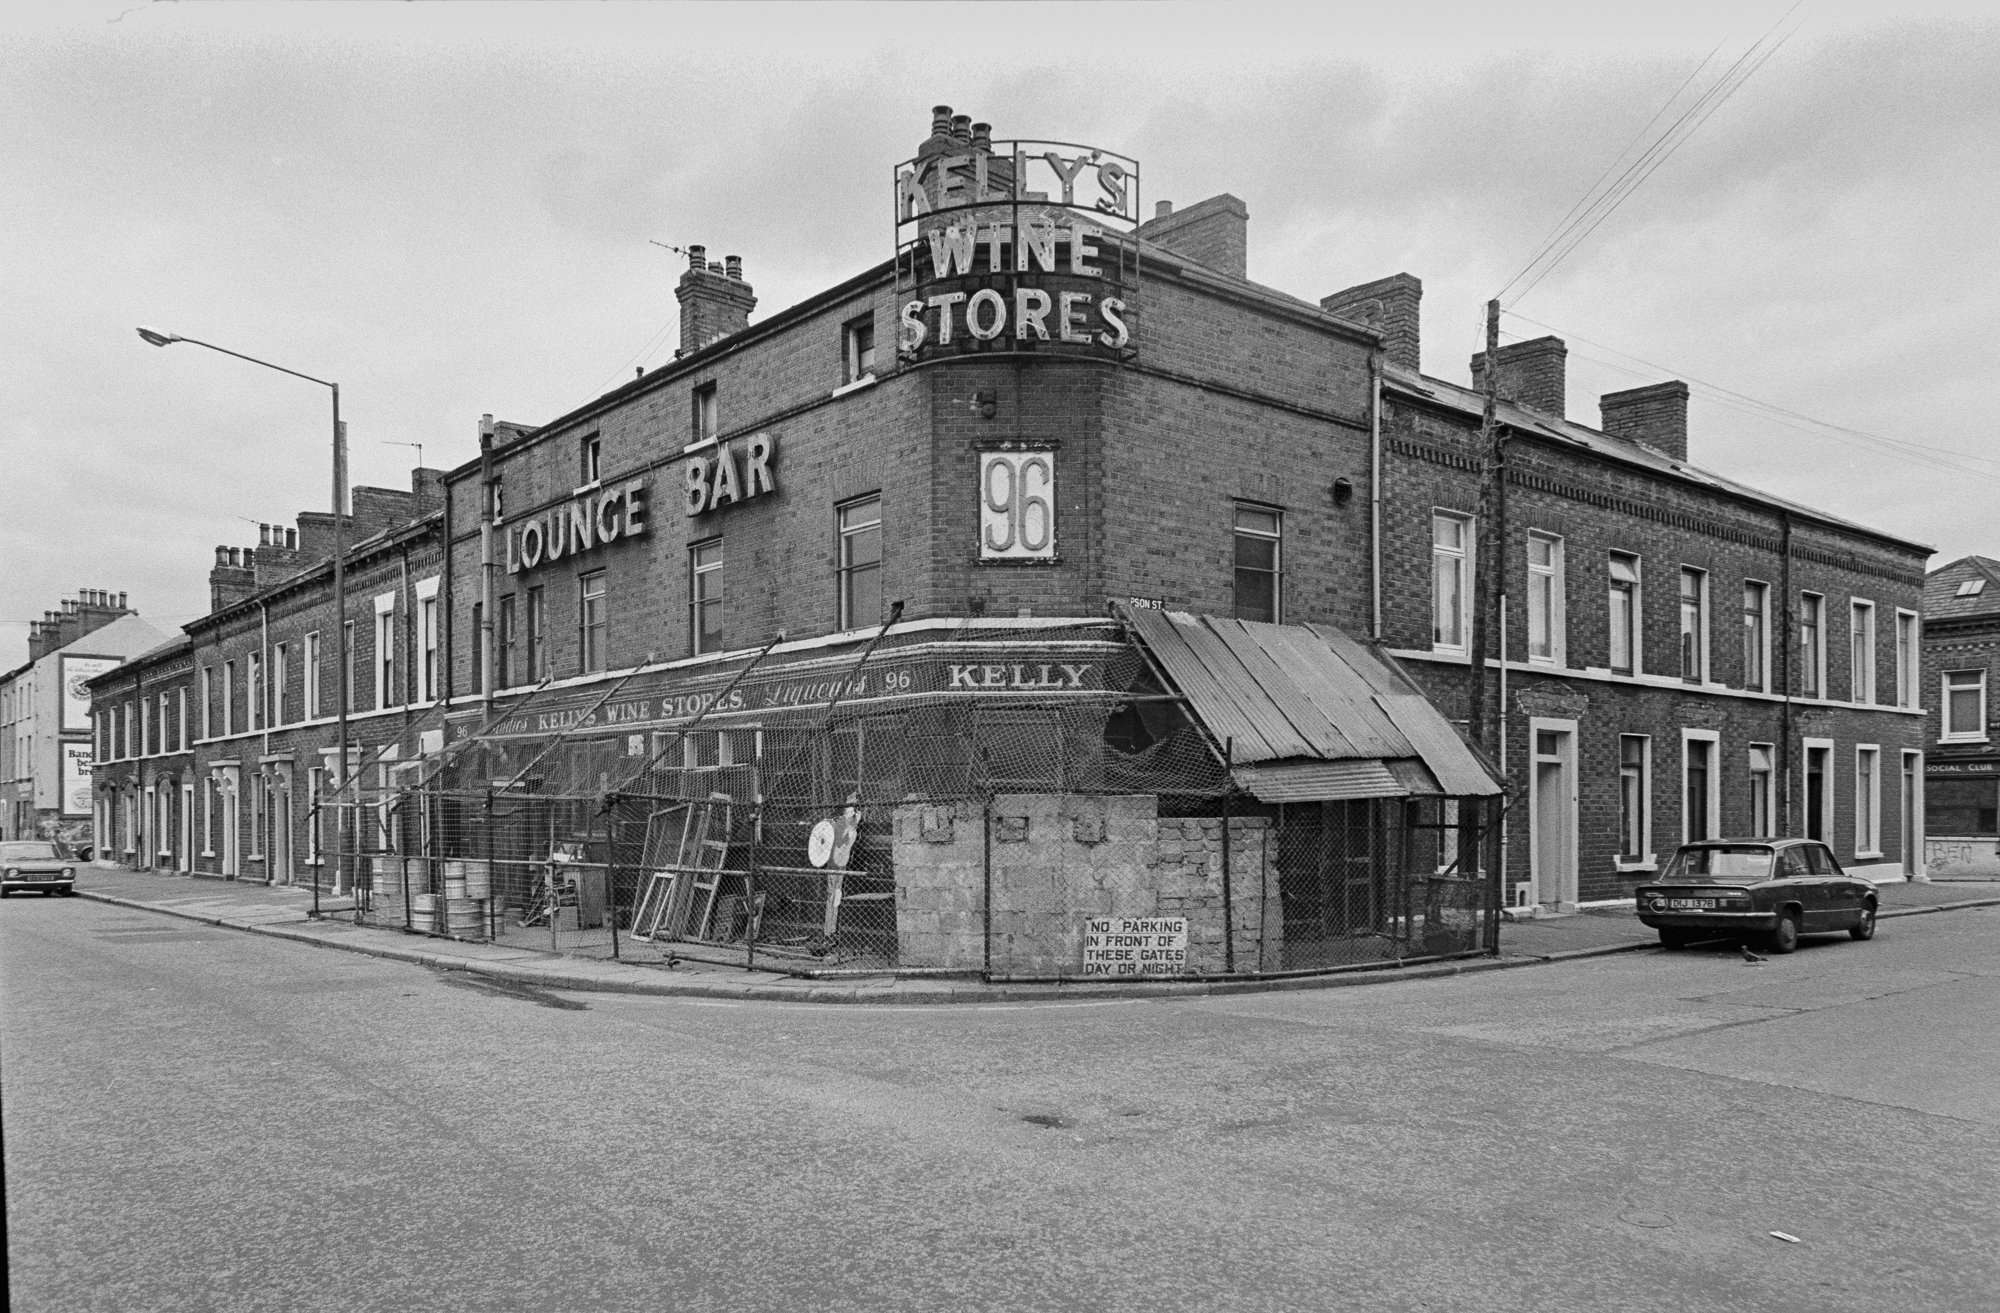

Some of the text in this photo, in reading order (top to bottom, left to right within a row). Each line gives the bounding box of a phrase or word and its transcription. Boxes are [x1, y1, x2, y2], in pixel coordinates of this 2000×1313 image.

[900, 150, 1127, 220] KELLY'S
[928, 220, 1102, 278] WINE
[901, 288, 1129, 351] STORES
[507, 433, 774, 574] LOUNGE BAR
[984, 456, 1050, 551] 96
[1152, 600, 1162, 609] ST
[949, 664, 1092, 687] KELLY
[456, 725, 468, 738] 96
[605, 701, 650, 721] WINE
[885, 670, 910, 689] 96
[1968, 763, 1993, 771] CLUB
[1091, 921, 1183, 933] NO PARKING
[1086, 935, 1176, 947] IN FRONT OF
[1086, 949, 1184, 960] THESE GATES
[1085, 963, 1183, 975] DAY OR NIGHT
